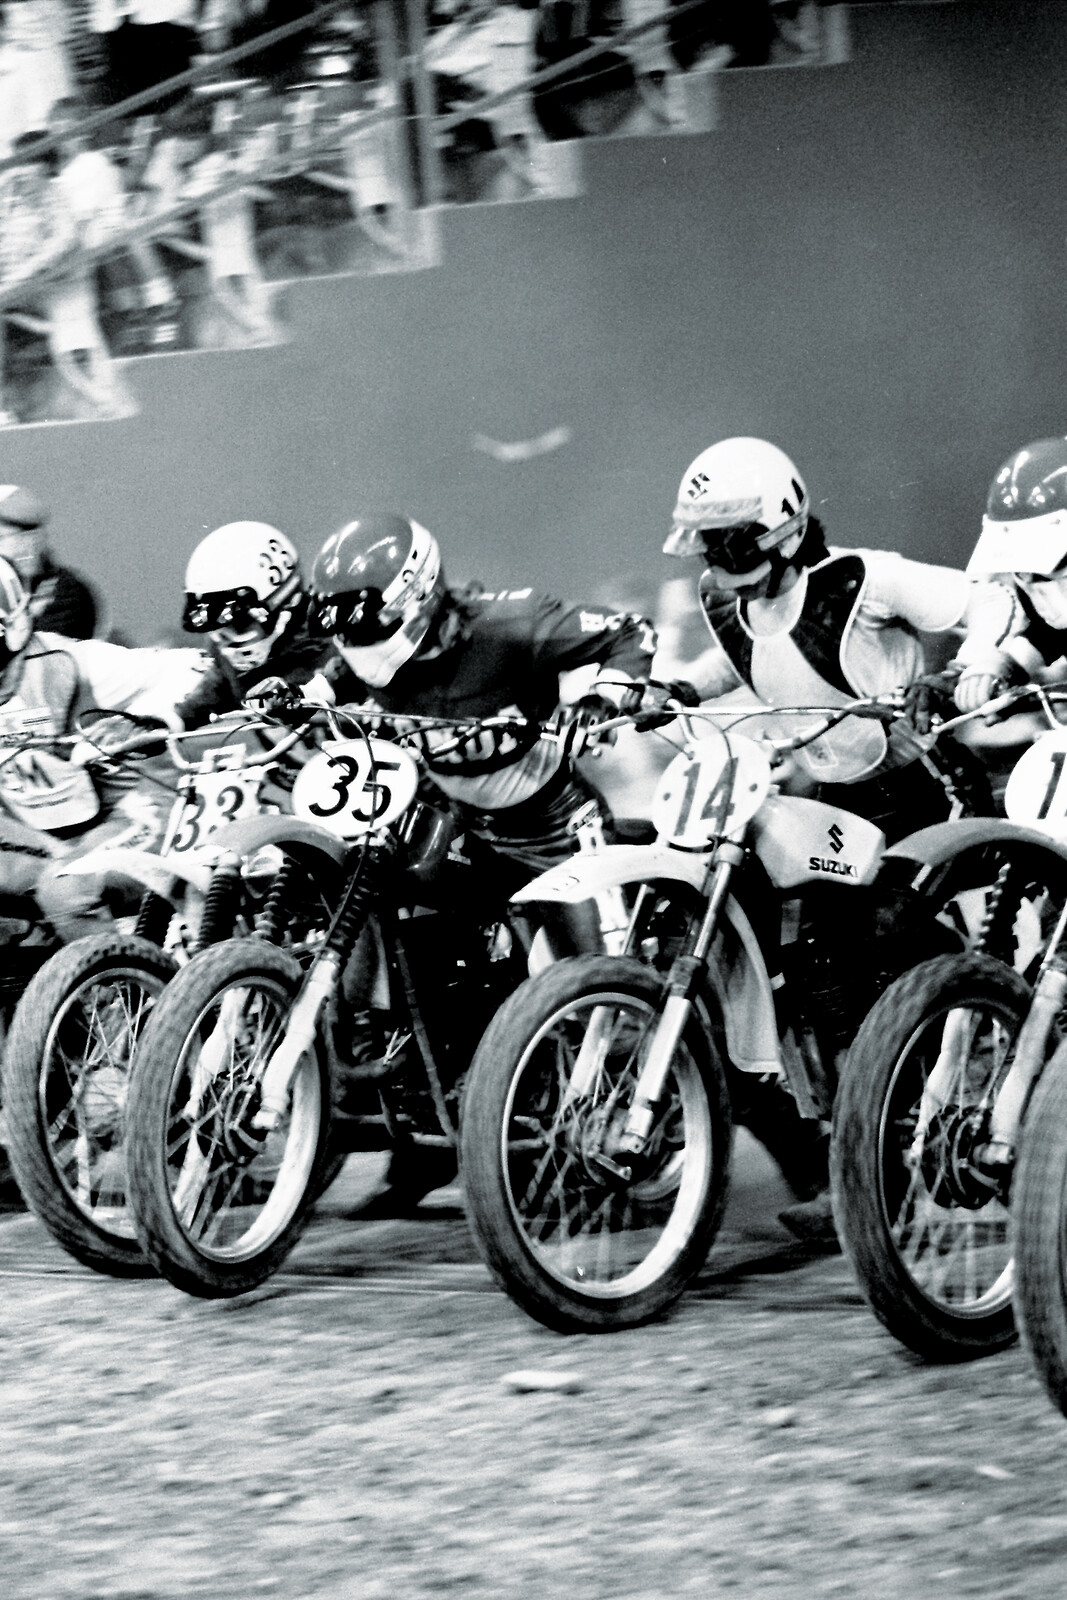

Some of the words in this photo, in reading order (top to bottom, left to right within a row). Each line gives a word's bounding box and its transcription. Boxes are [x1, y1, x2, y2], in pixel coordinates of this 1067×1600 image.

[308, 755, 402, 822] 35
[673, 757, 738, 837] 14
[1037, 752, 1067, 820] 1
[809, 857, 858, 877] SUZUKI
